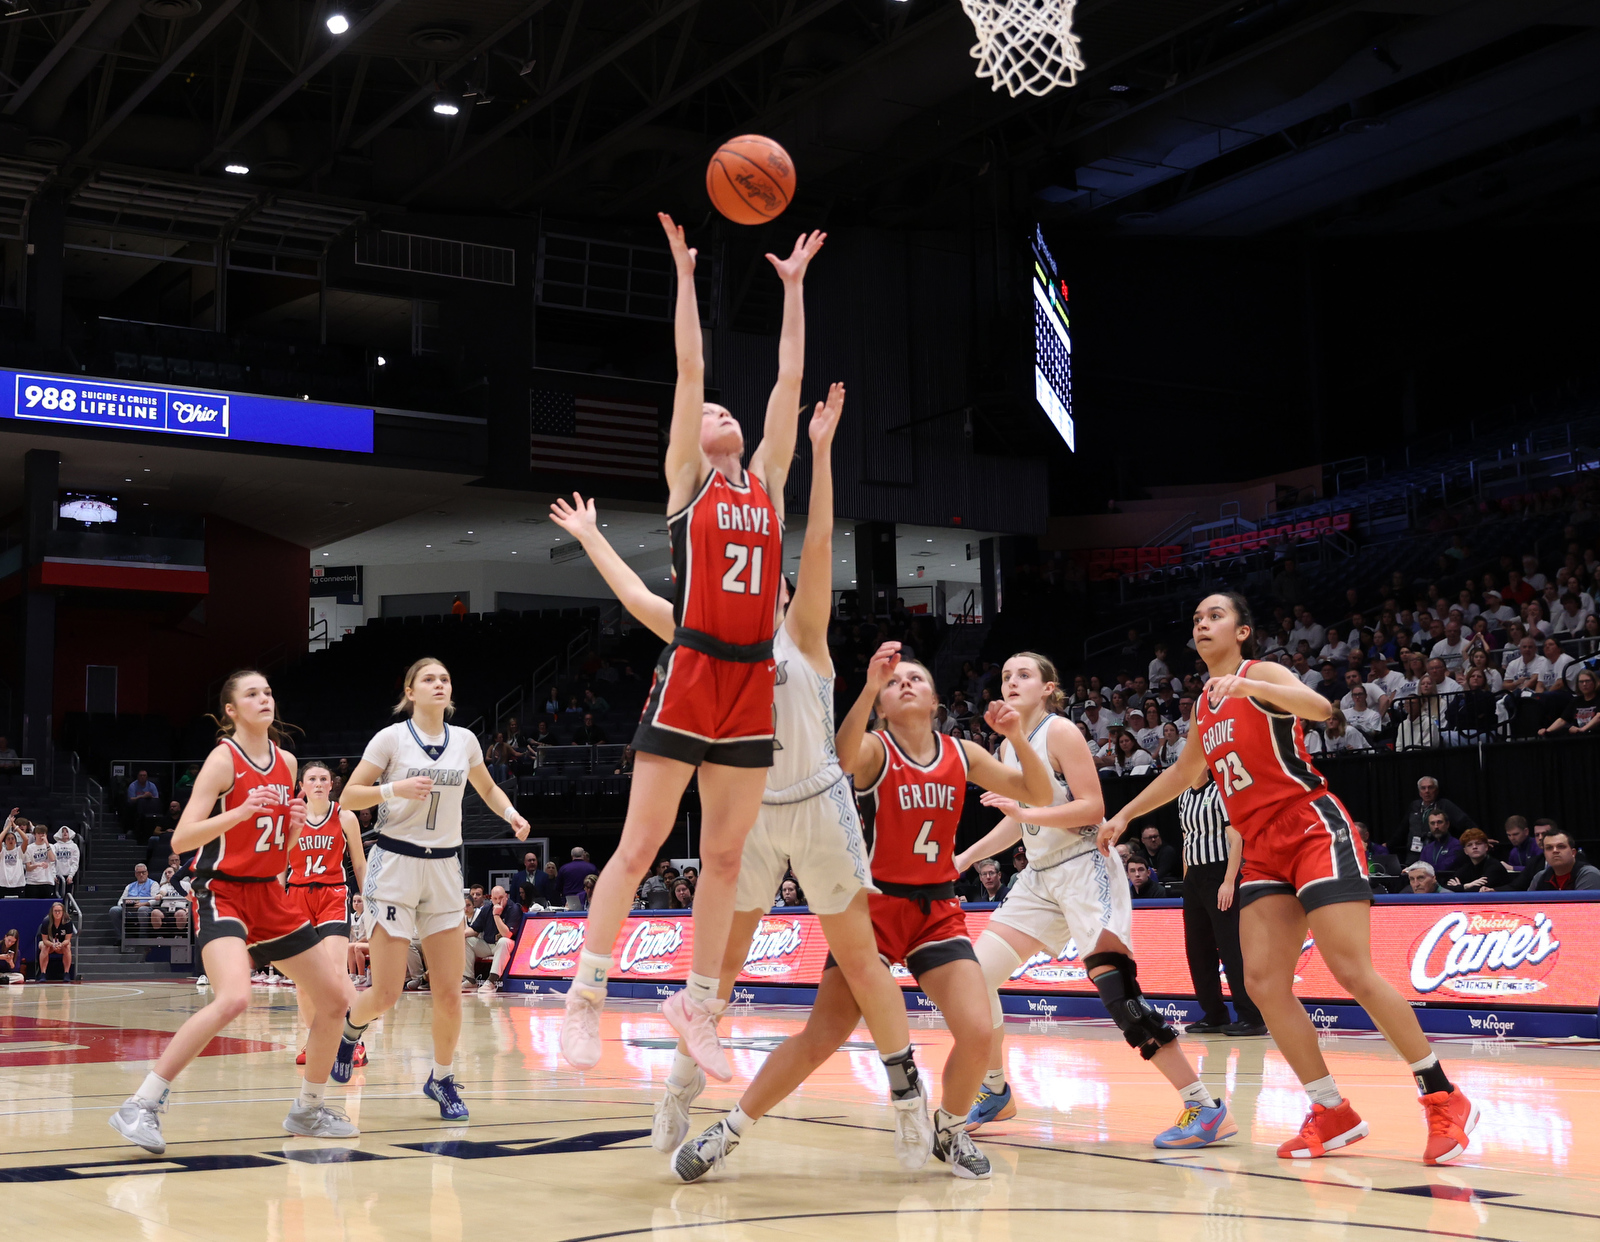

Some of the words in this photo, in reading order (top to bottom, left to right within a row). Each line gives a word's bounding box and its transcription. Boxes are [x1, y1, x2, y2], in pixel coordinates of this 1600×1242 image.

[25, 385, 77, 412] 988
[80, 400, 158, 420] LIFELINE
[81, 390, 118, 402] SUICIDE
[119, 394, 126, 403] &
[127, 395, 158, 406] CRISIS
[717, 502, 770, 536] GROVE
[320, 574, 357, 583] connection
[722, 542, 763, 594] 21
[1202, 718, 1236, 756] GROVE
[898, 782, 956, 811] GROVE
[426, 791, 440, 830] 1
[255, 815, 285, 852] 24
[298, 835, 335, 851] GROVE
[913, 820, 940, 863] 4
[386, 906, 397, 921] R
[1468, 915, 1520, 932] Raising
[530, 921, 586, 969] Cane's
[620, 921, 683, 972] Cane's
[1410, 912, 1560, 994] Cane's
[1037, 998, 1058, 1017] Kroger
[1164, 1003, 1188, 1021] Kroger
[1312, 1008, 1338, 1028] Kroger
[1482, 1014, 1515, 1035] Kroger
